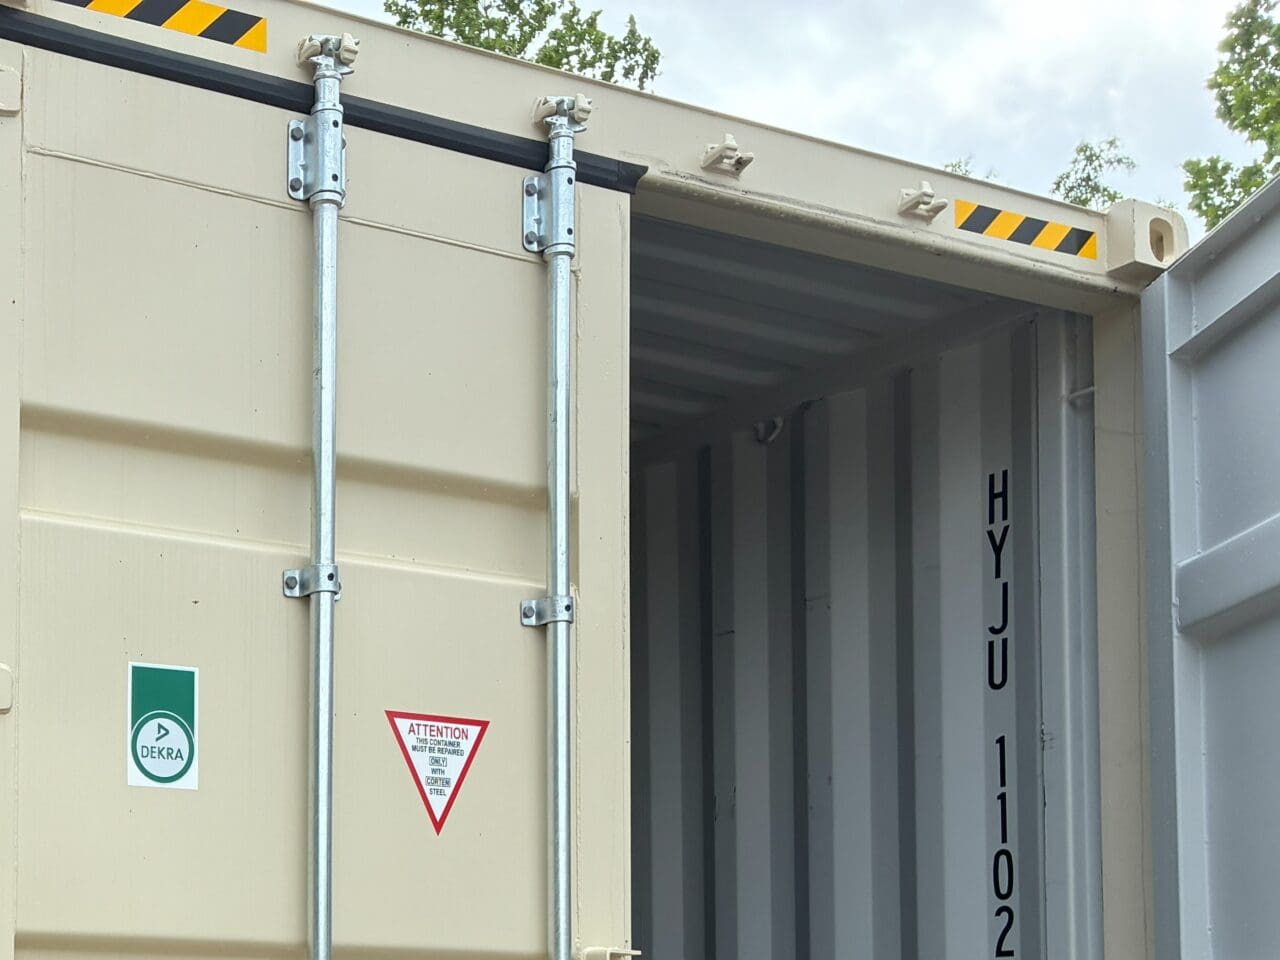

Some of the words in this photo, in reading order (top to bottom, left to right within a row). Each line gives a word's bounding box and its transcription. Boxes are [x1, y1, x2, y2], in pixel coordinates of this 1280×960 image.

[986, 469, 1010, 690] HYJU
[408, 723, 469, 740] ATTENTION
[416, 737, 428, 745] THIS
[429, 739, 461, 748] CONTAINER
[140, 744, 185, 762] DEKRA
[412, 745, 427, 753] MUST
[428, 746, 436, 754] BE
[437, 747, 465, 756] REPAIRED
[430, 757, 446, 766] ONLY
[431, 768, 445, 776] WITH
[426, 777, 451, 786] CORTEN
[429, 788, 446, 796] STEEL
